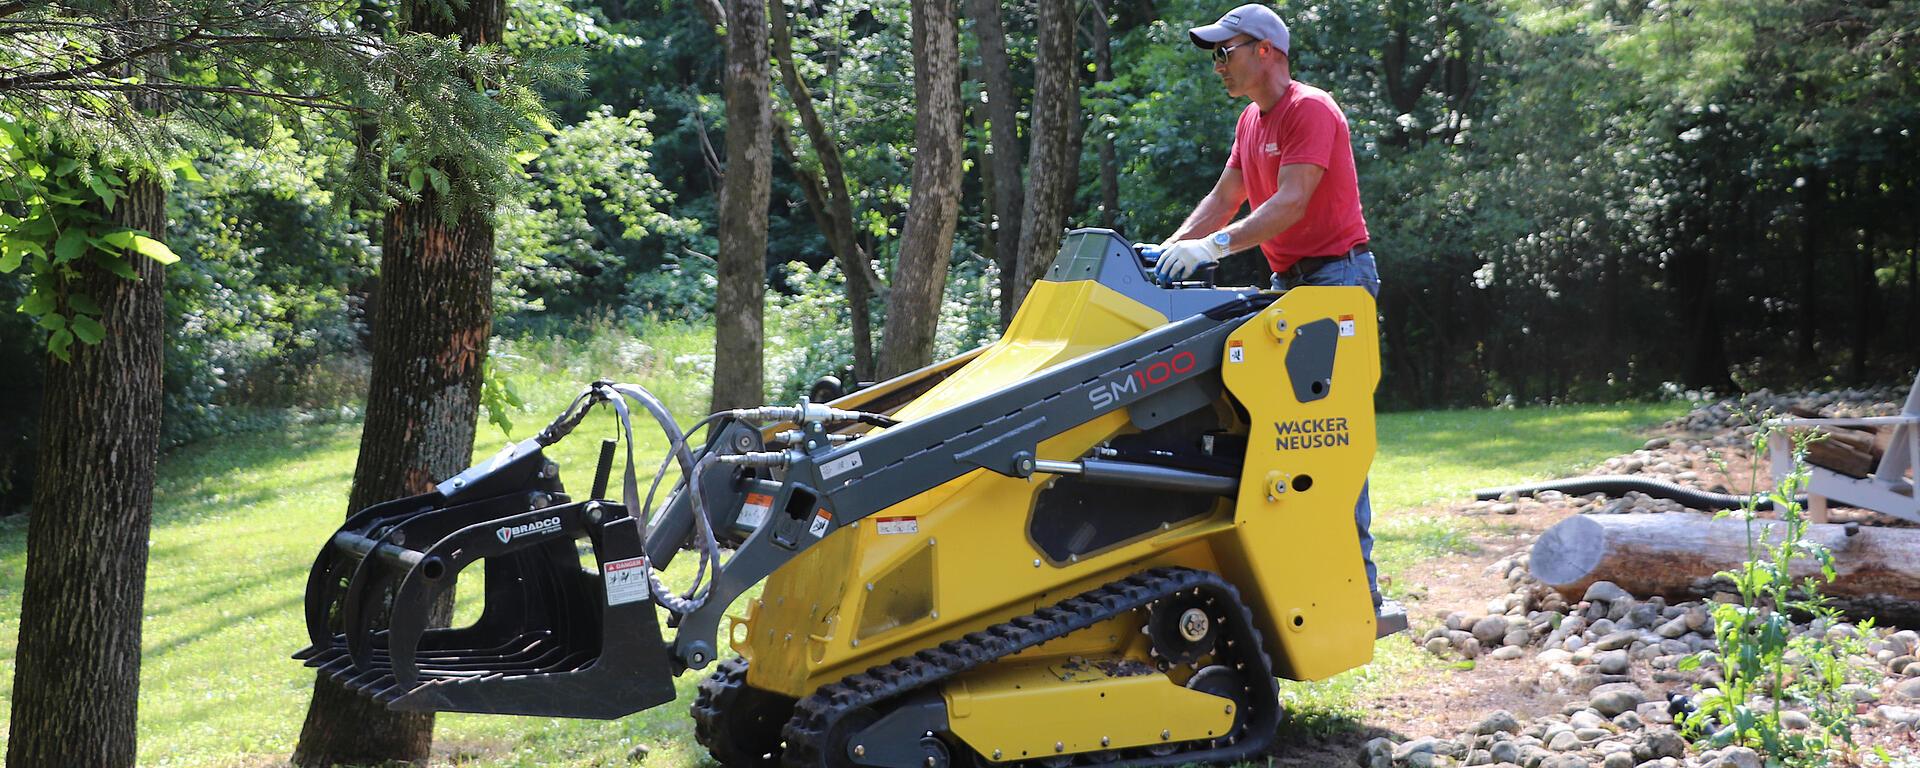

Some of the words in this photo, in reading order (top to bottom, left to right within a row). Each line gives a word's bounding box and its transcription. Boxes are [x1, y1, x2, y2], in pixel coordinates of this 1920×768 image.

[1088, 351, 1196, 411] SM100
[1274, 417, 1348, 435] WACKER
[1276, 432, 1349, 451] NEUSON
[511, 516, 561, 535] BRADCO
[615, 560, 642, 569] DANGER
